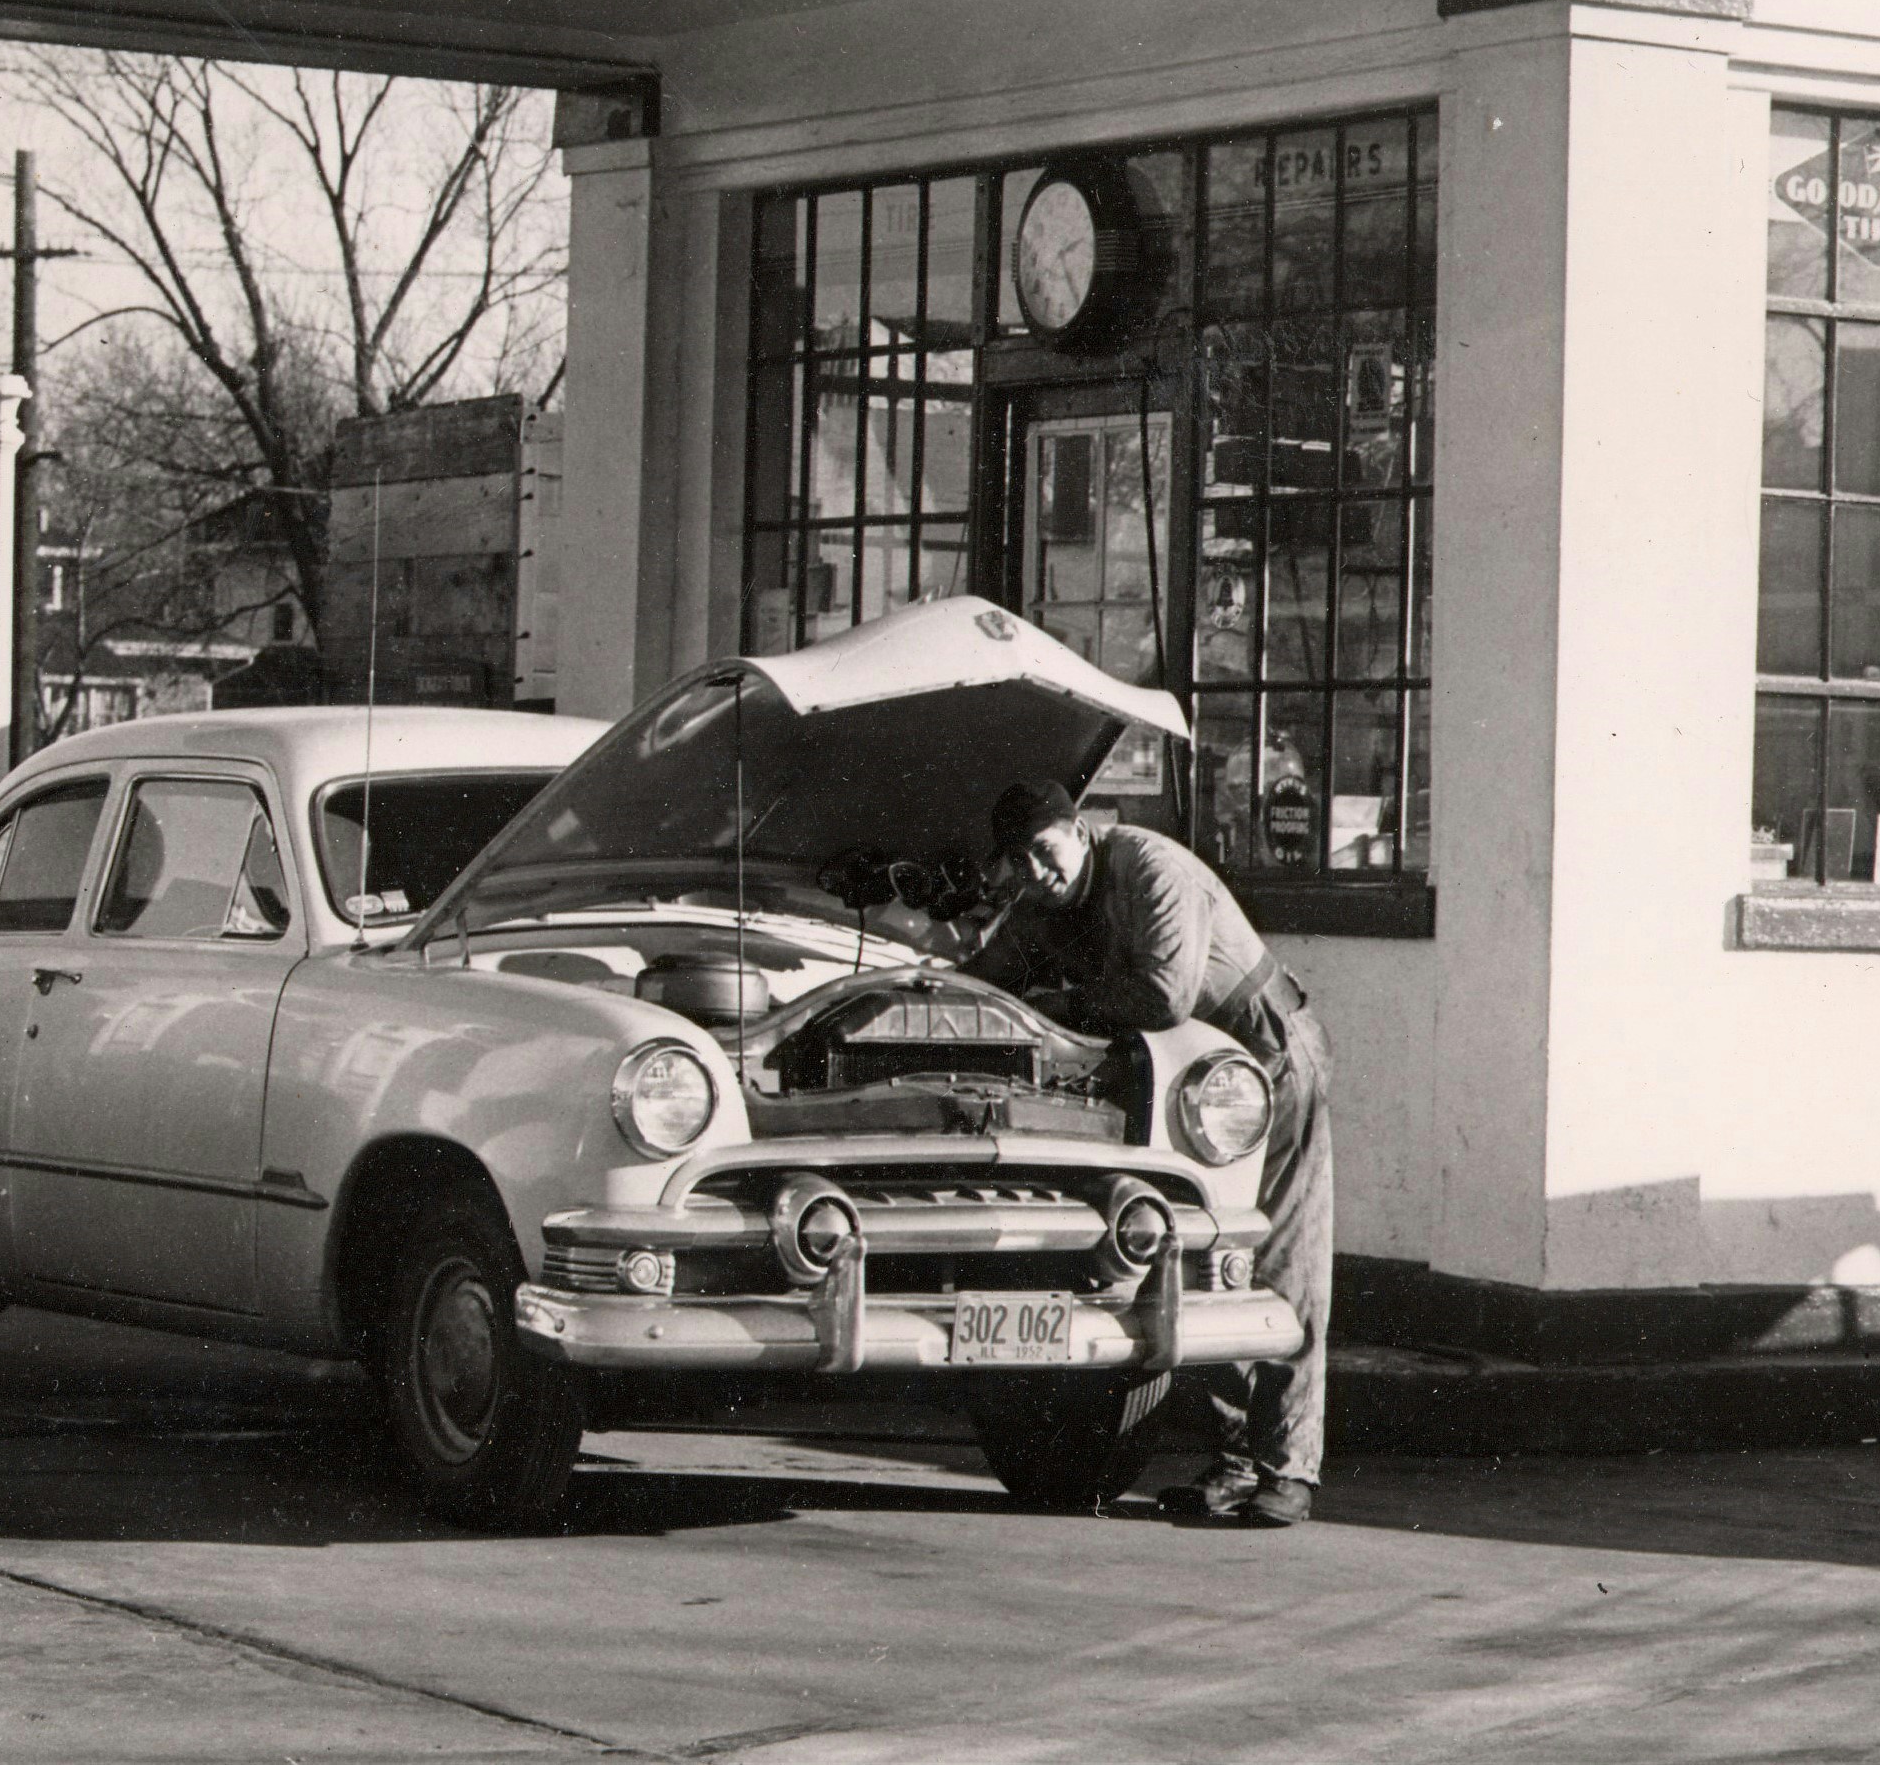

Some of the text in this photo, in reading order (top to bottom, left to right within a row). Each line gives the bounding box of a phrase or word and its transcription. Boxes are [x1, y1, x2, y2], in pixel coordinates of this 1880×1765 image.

[1270, 806, 1310, 820] FRICTION
[960, 1303, 1066, 1344] 302 062
[980, 1346, 998, 1359] ILL
